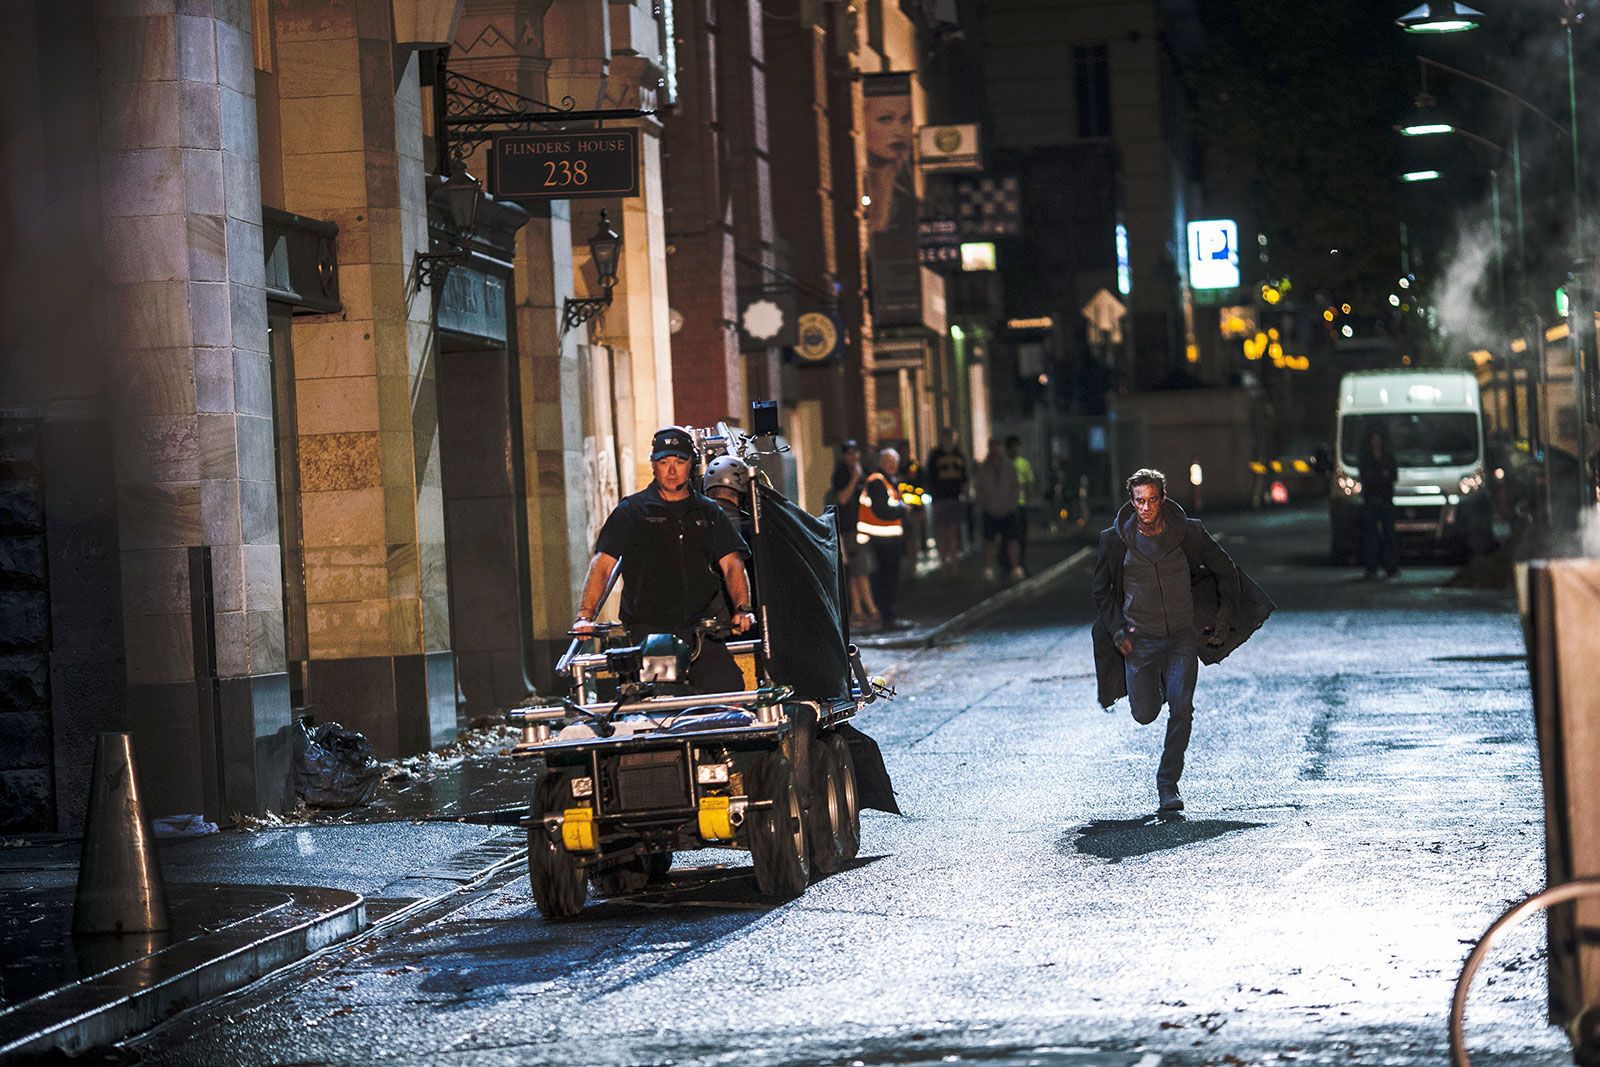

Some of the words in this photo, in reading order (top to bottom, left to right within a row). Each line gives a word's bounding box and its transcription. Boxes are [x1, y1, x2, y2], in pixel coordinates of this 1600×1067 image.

[505, 141, 571, 155] FLINDERS
[577, 139, 625, 153] HOUSE
[543, 159, 589, 187] 238
[1198, 230, 1227, 260] P
